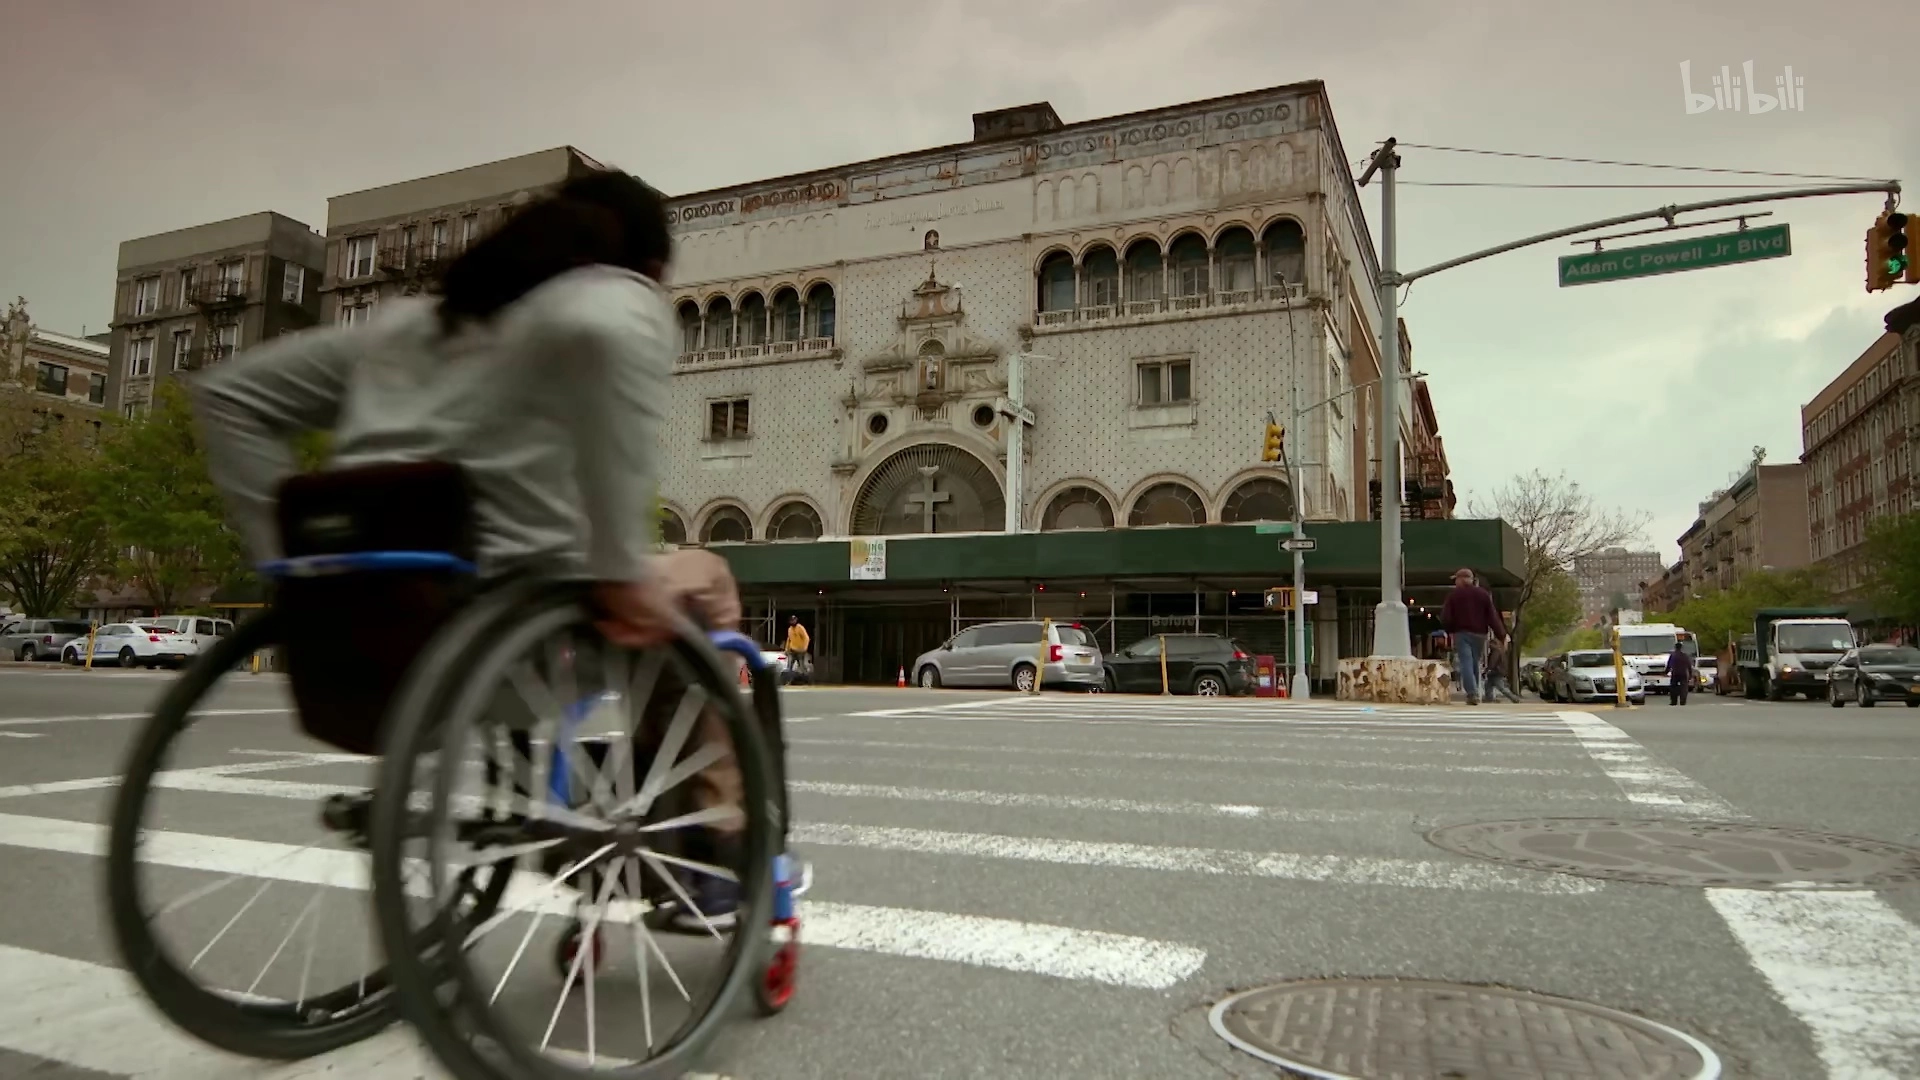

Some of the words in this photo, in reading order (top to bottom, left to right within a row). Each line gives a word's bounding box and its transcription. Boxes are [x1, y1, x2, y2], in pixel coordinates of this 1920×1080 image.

[1565, 260, 1618, 280] Adam
[1622, 256, 1634, 270] C
[1640, 246, 1702, 268] Powell
[1709, 243, 1730, 257] Jr
[1737, 234, 1784, 255] Blvd
